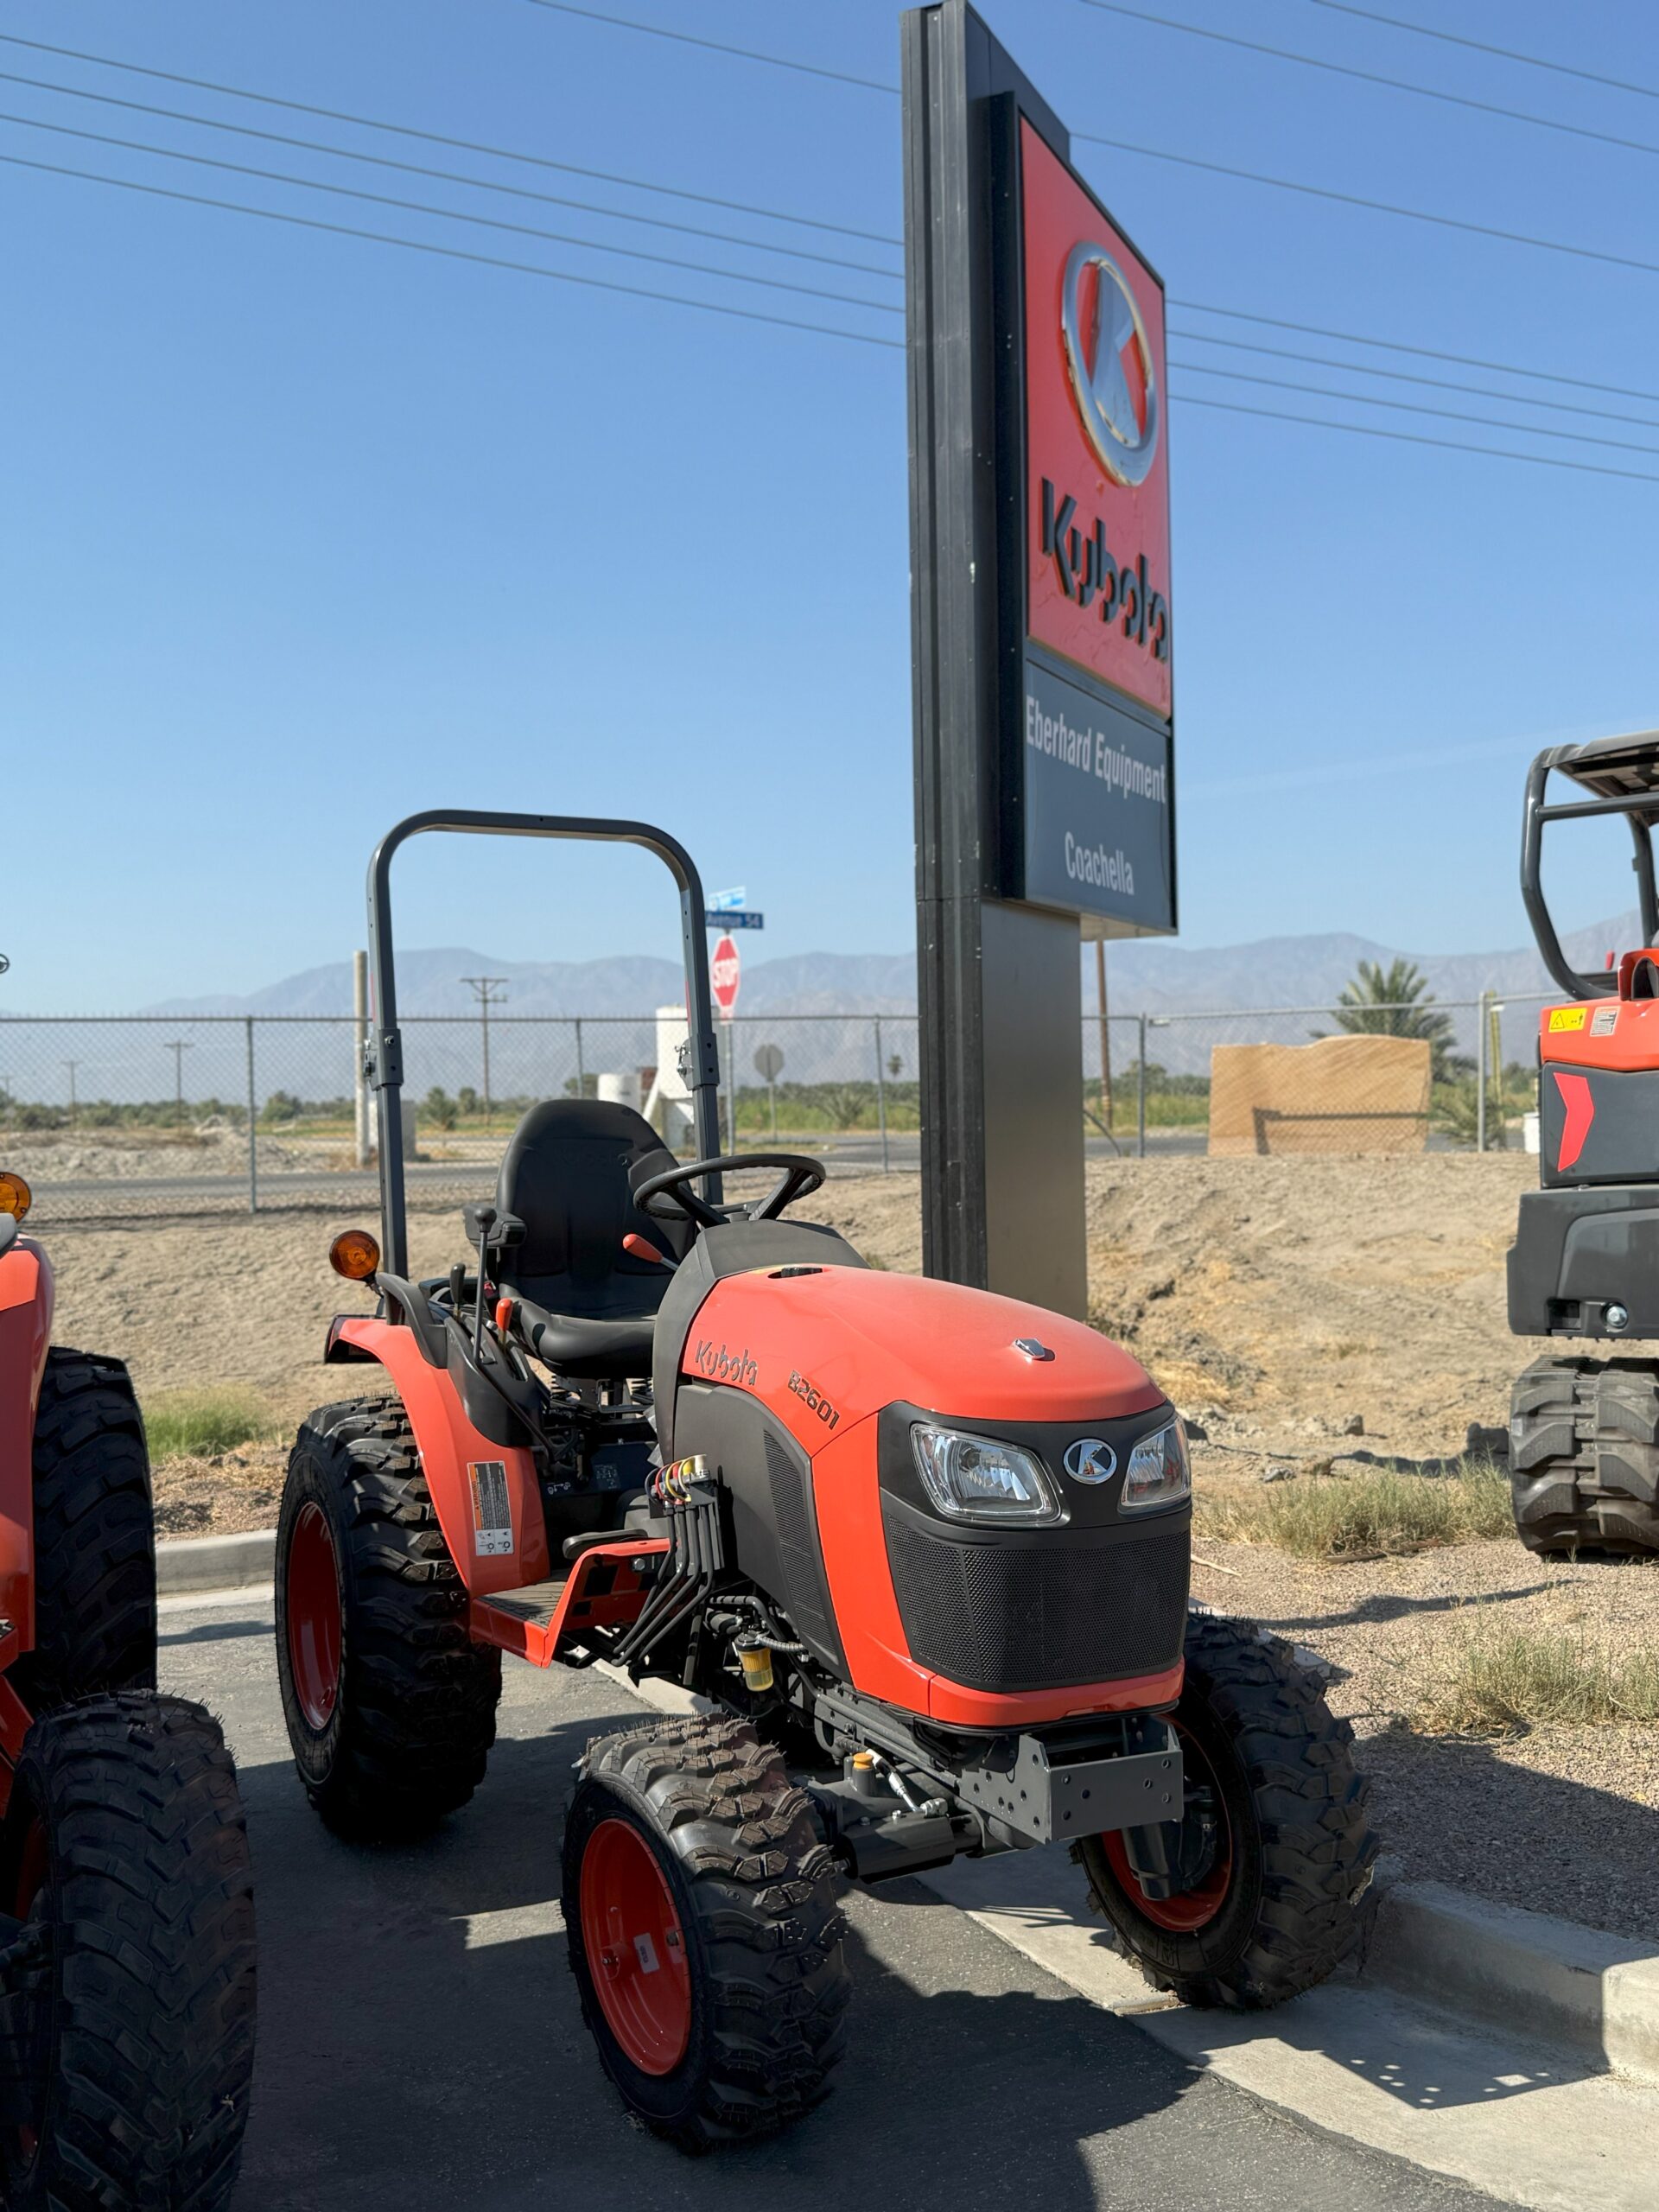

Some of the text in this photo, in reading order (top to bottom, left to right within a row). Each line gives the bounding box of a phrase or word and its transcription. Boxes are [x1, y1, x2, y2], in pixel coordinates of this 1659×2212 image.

[1041, 476, 1170, 664] Kubota
[1026, 695, 1166, 804] Eberhard Equipment
[1065, 830, 1135, 896] Coachella
[713, 957, 739, 988] STOP
[695, 1339, 758, 1386] Kubota
[787, 1370, 840, 1430] B2601
